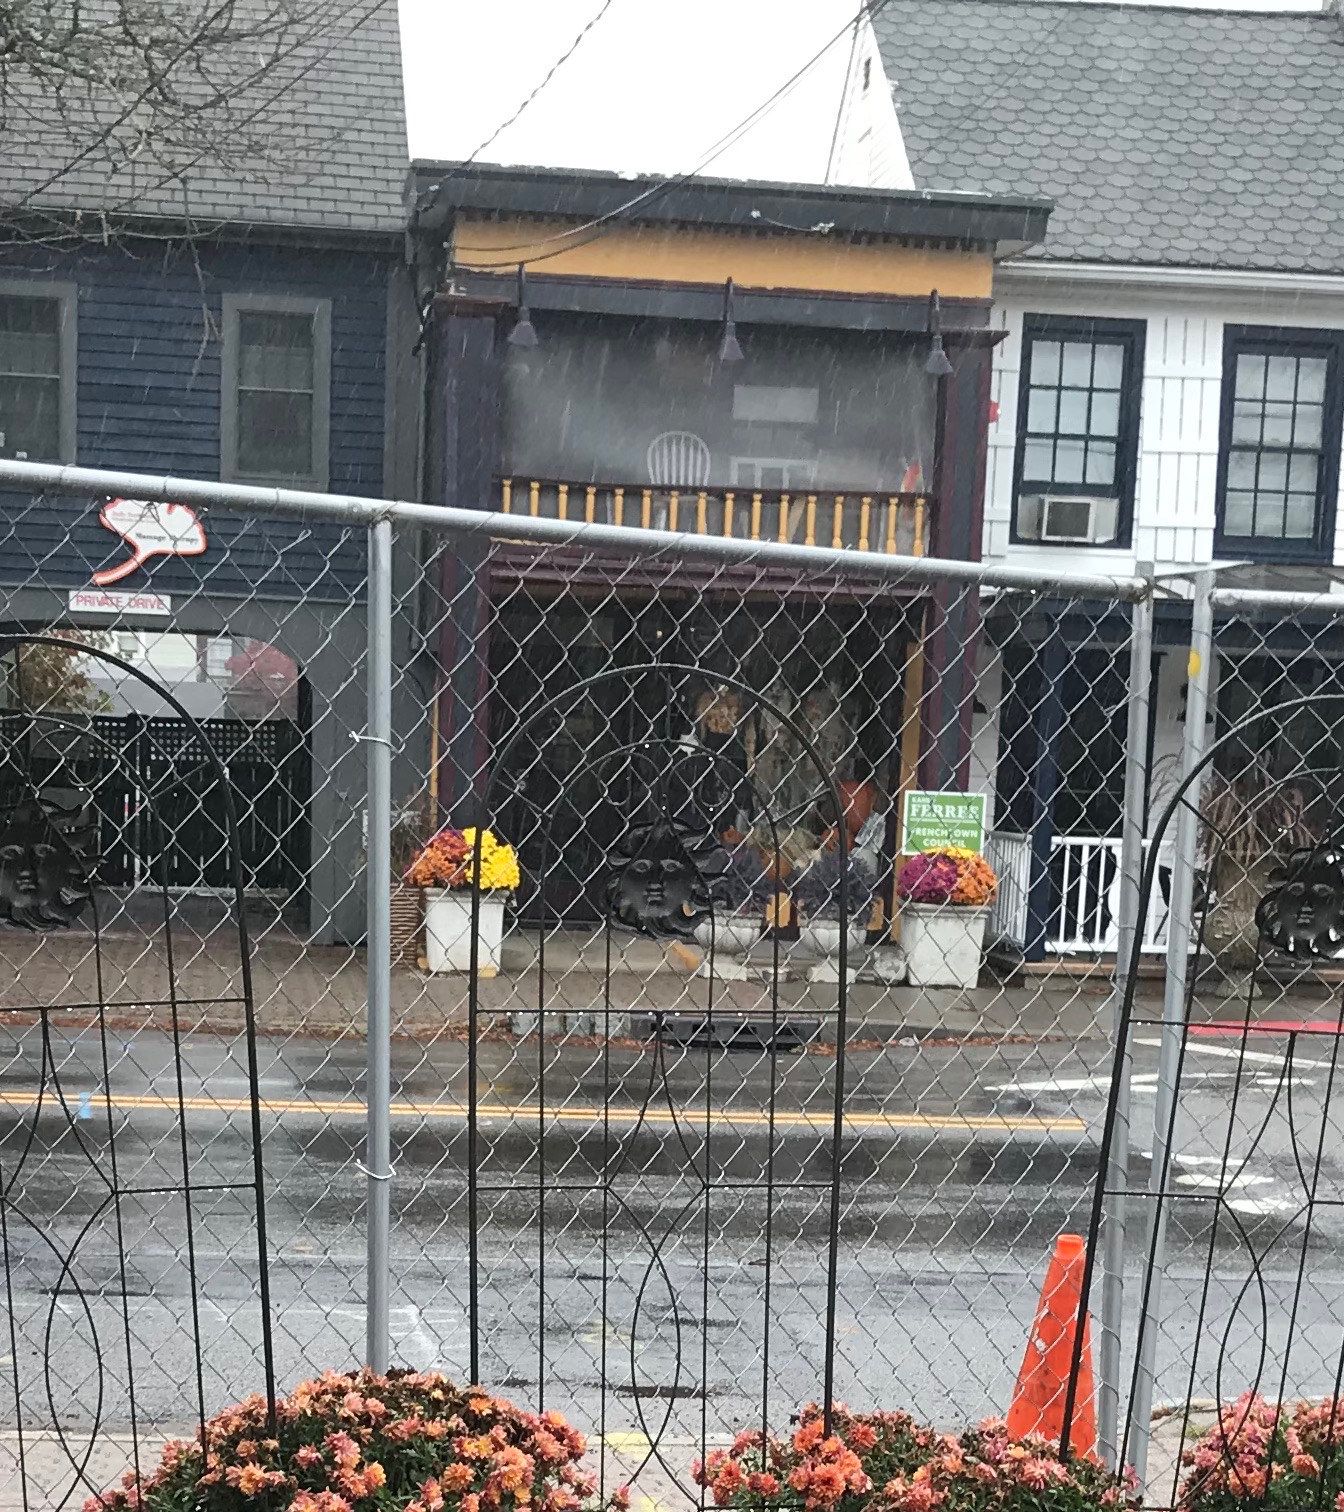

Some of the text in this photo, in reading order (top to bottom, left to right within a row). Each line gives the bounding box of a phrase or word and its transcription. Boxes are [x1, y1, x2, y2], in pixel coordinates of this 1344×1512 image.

[75, 594, 165, 611] PRIVATE DRIVE
[910, 827, 978, 838] RENCHOWN
